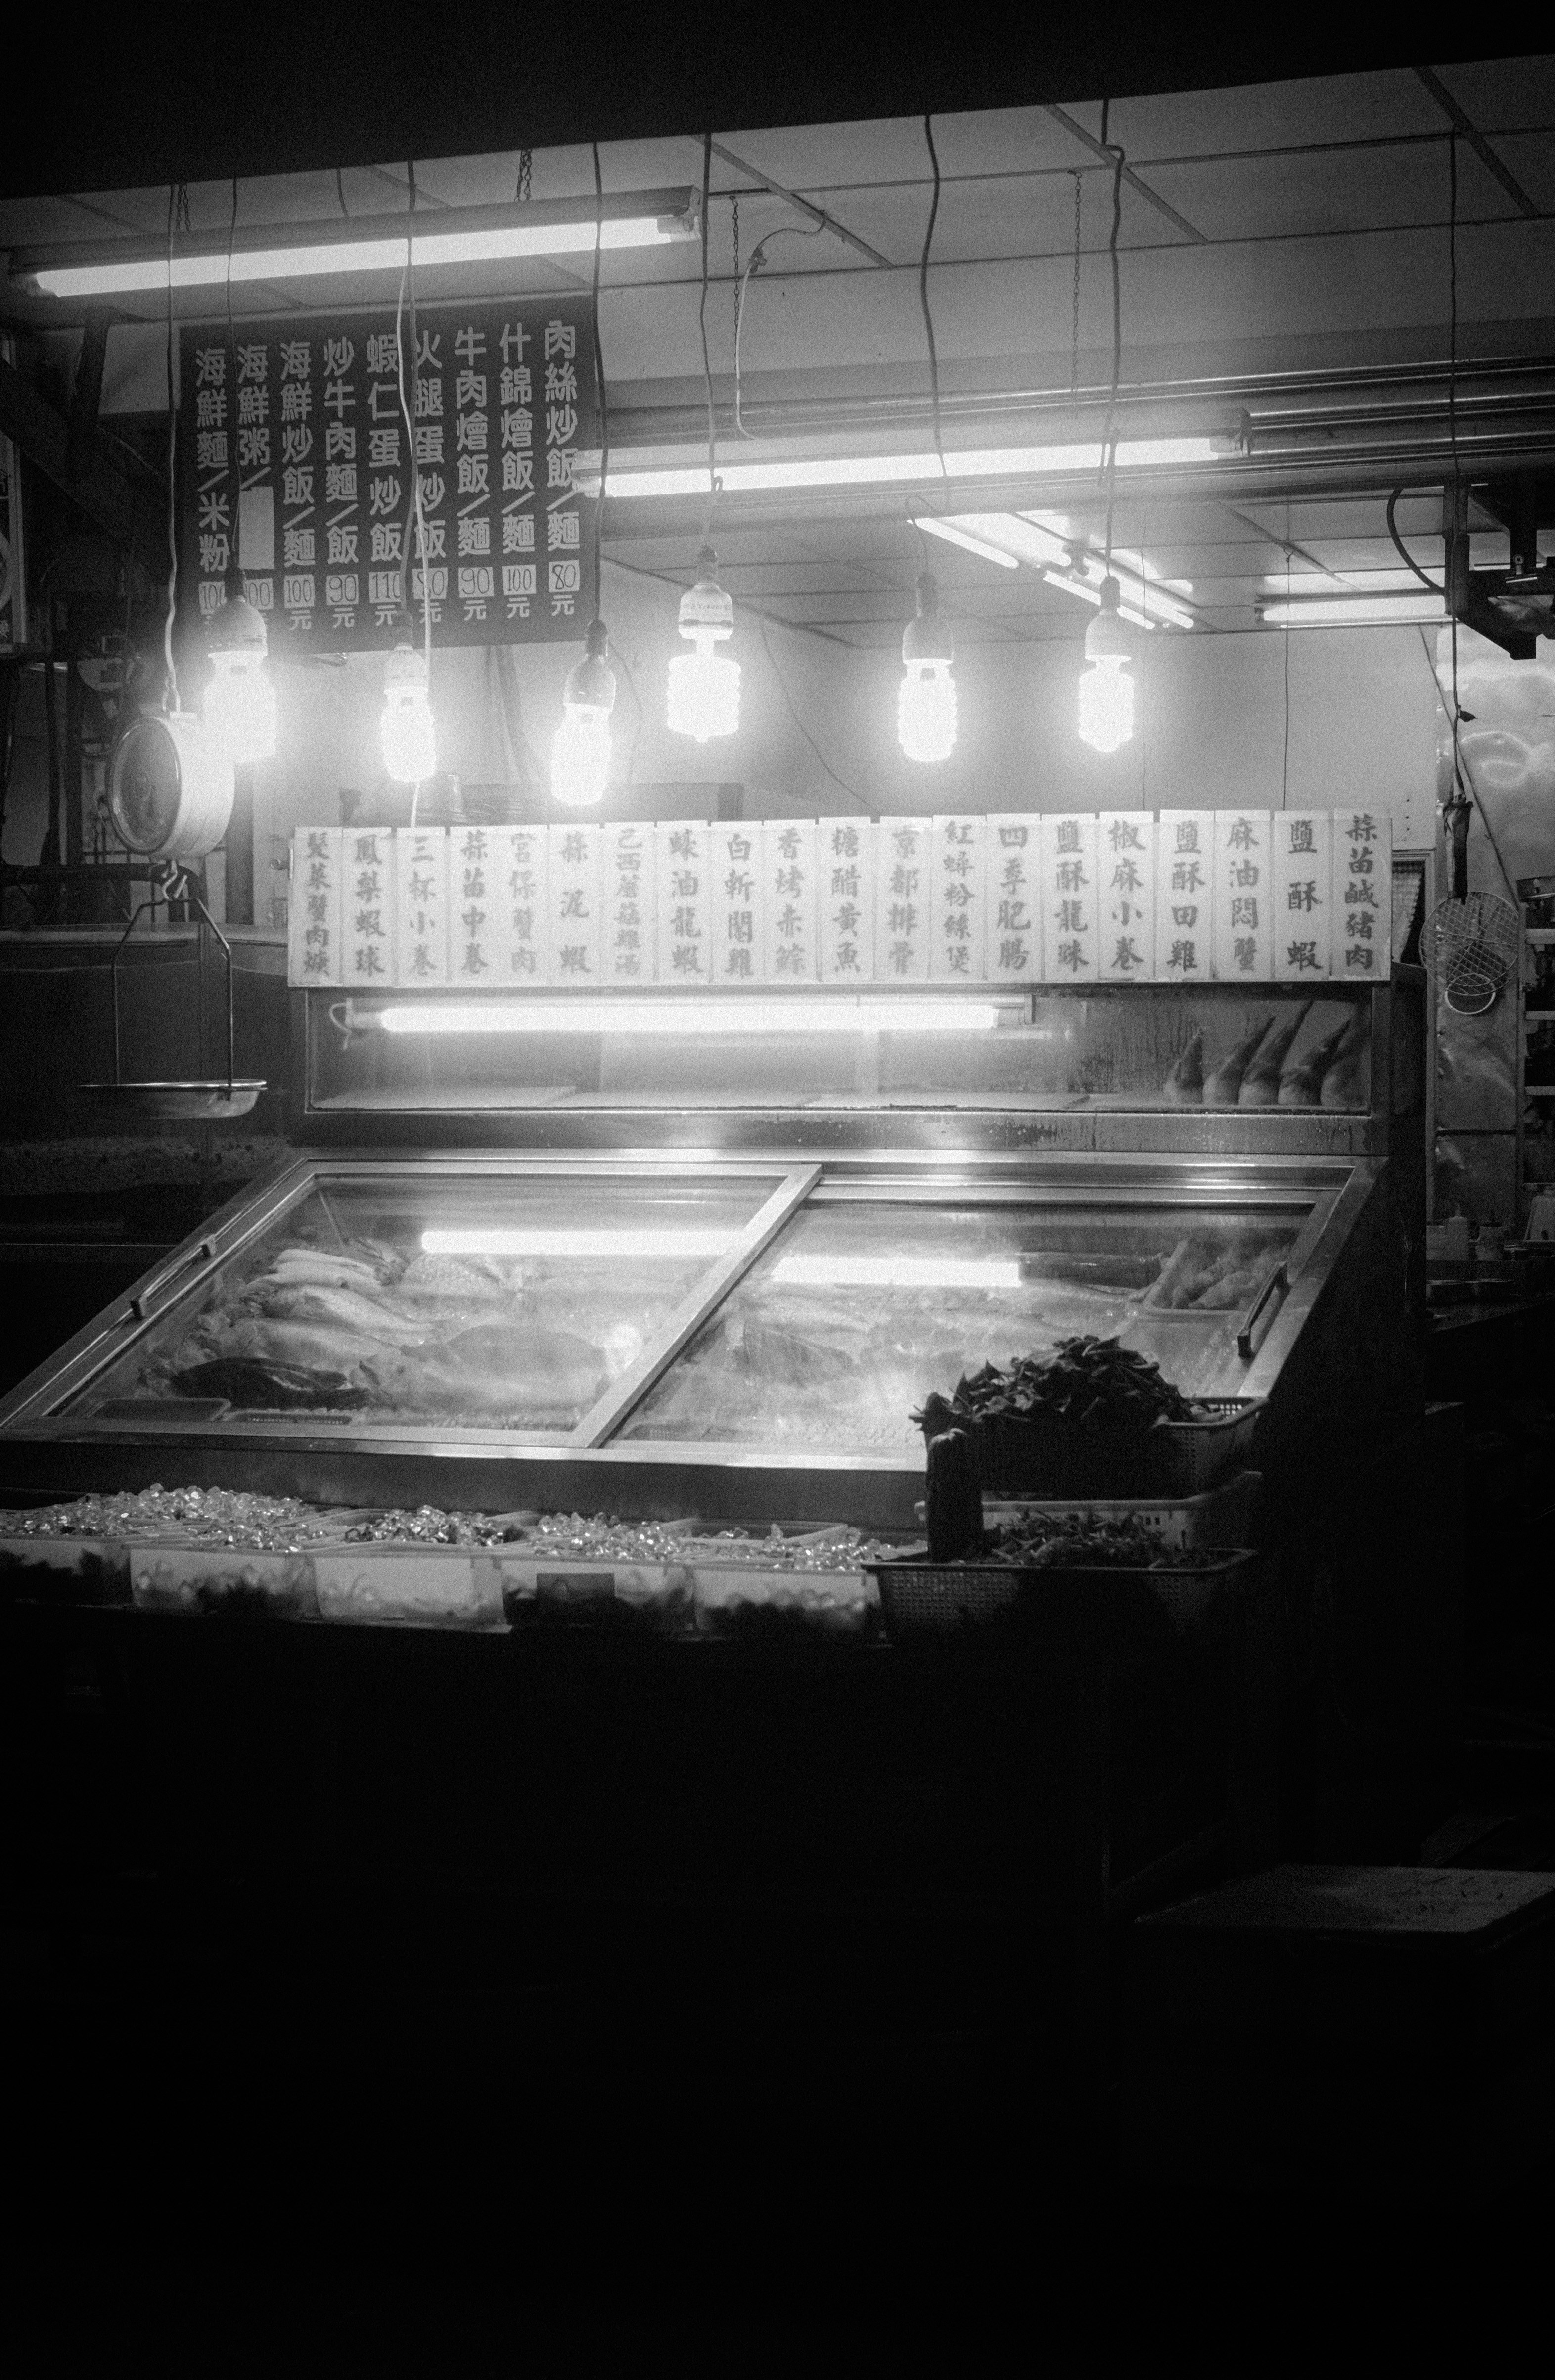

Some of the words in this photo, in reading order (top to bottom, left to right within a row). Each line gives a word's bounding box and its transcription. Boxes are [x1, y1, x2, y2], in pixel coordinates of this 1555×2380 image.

[280, 341, 316, 569] 海鮮炒飯/麵
[324, 337, 359, 565] 炒牛肉麵/飯
[455, 327, 490, 557] 牛肉燴飯/麵
[499, 322, 535, 554] 什錦燴飯/麵
[355, 834, 386, 977] 鳳梨蝦球
[509, 833, 536, 974] 宮保蟹肉
[560, 831, 592, 974] 蒜泥蝦
[669, 828, 703, 975] 蠔油龍蝦
[888, 825, 919, 974] 京都排骨
[997, 826, 1031, 970] 四季肥腸
[1055, 820, 1090, 972] 鹽酥龍珠
[1167, 820, 1205, 970] 鹽酥田雞
[1287, 820, 1323, 971] 鹽酥蝦
[1344, 813, 1378, 970] 蒜苗鹹豬肉
